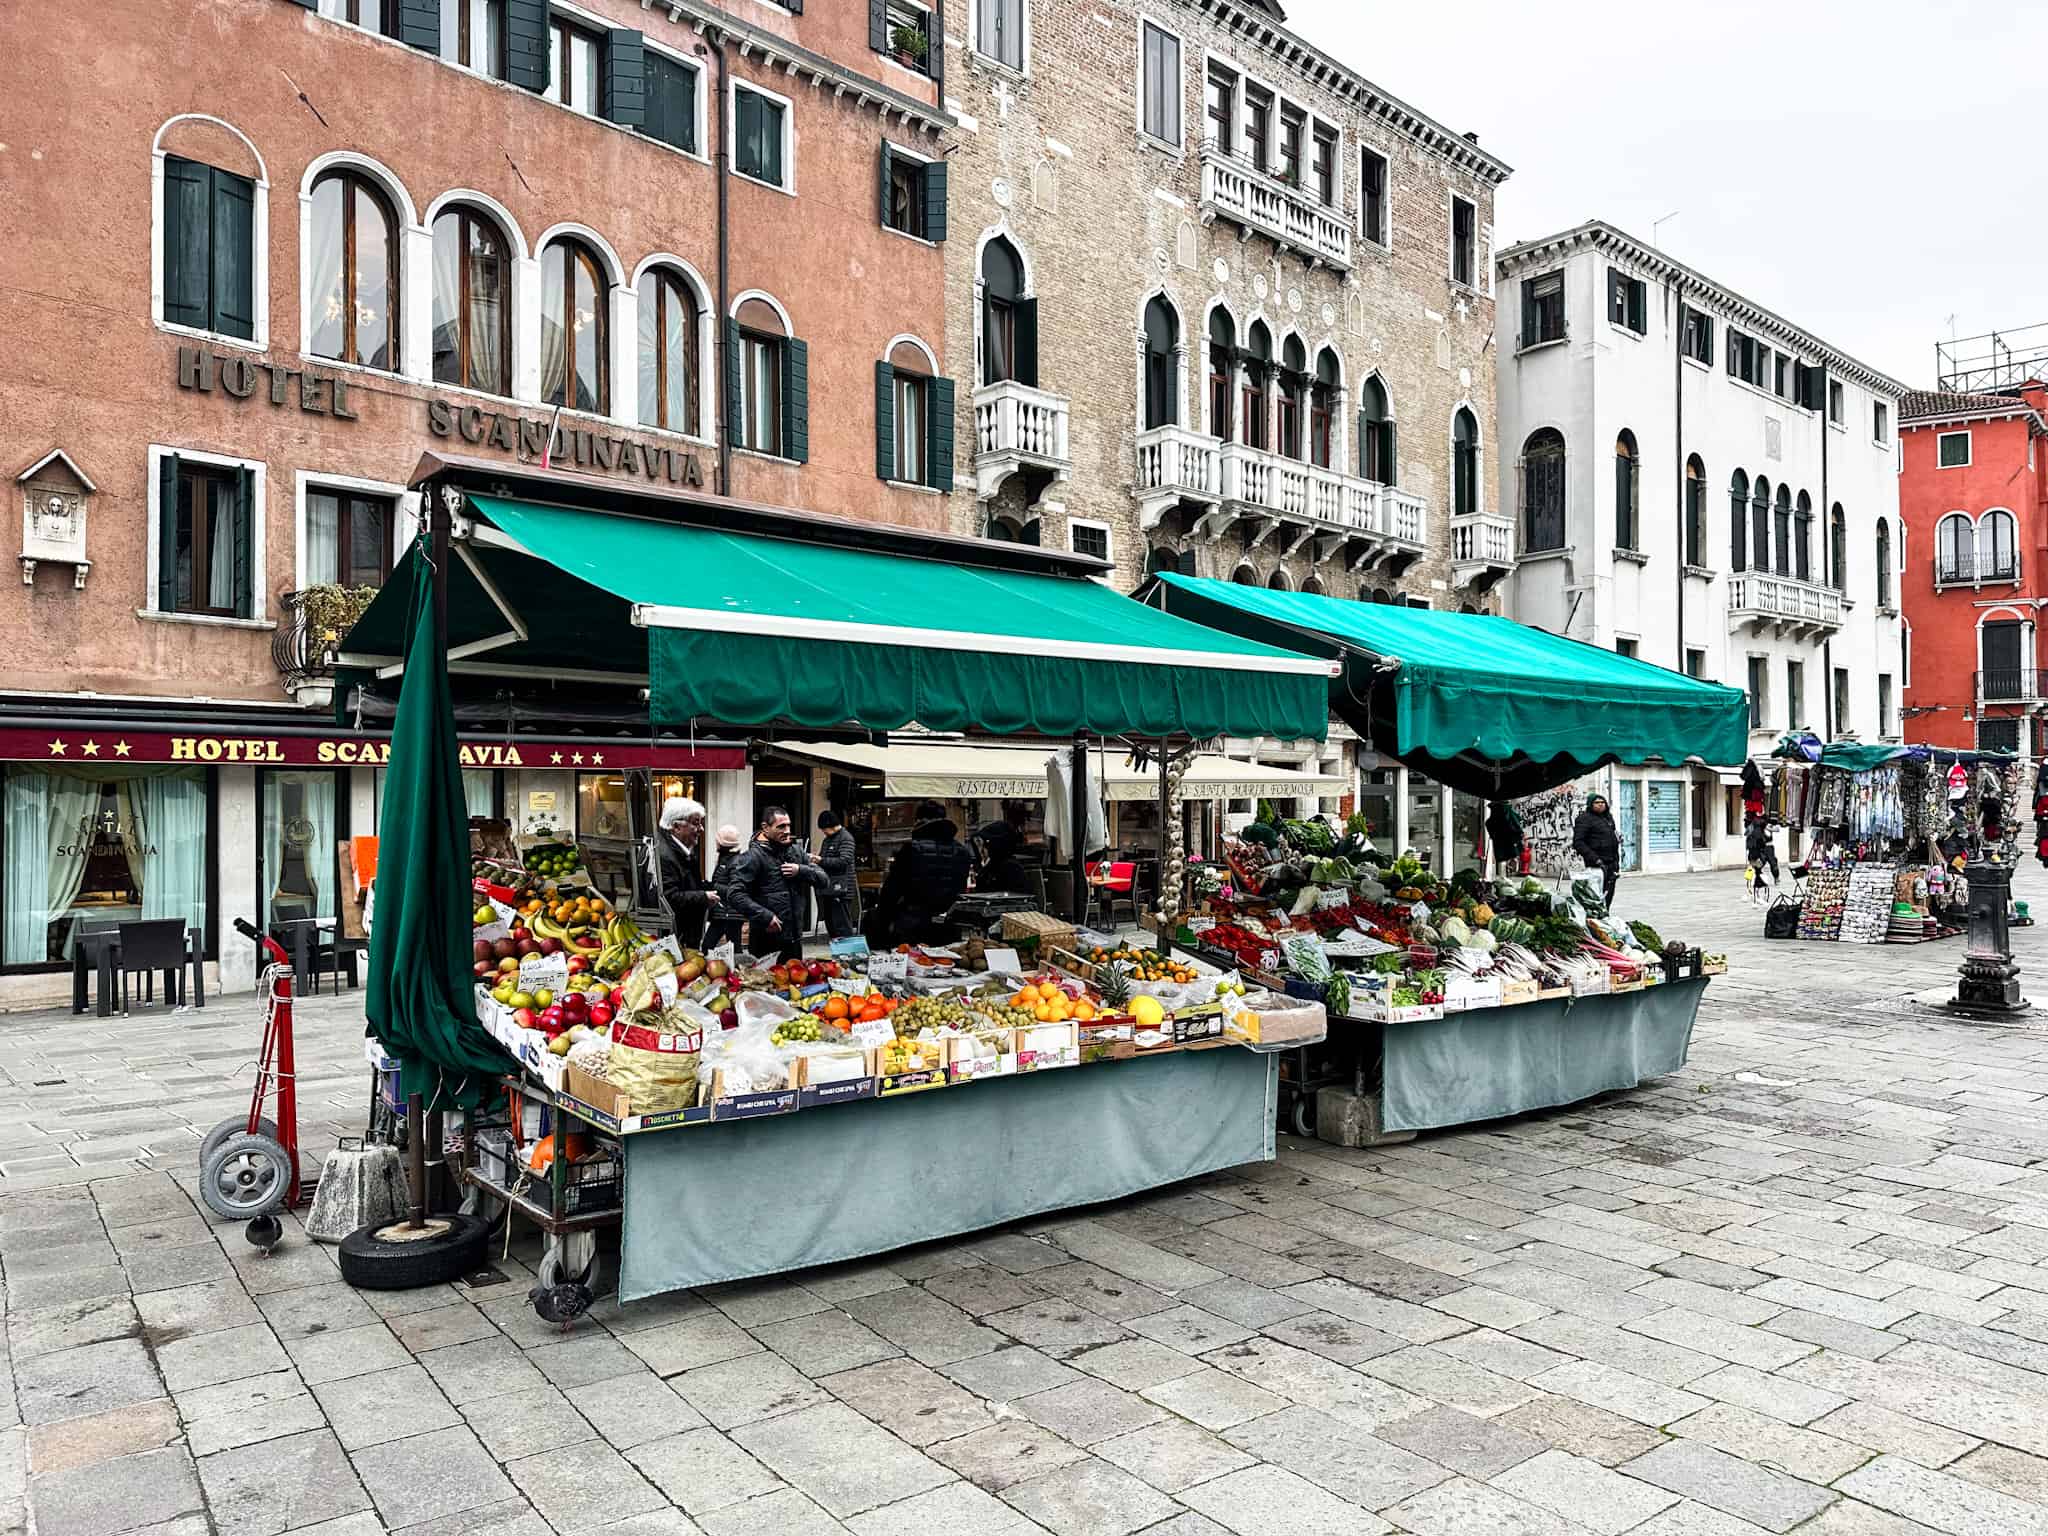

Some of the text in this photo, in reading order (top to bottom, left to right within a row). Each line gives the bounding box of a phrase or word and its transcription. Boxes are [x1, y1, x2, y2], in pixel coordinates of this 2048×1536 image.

[179, 346, 704, 487] HOTEL SCANDINAVIA
[170, 738, 285, 762] HOTEL
[957, 780, 1045, 796] RISTORANTE
[1193, 784, 1226, 797] SANTA
[1231, 784, 1265, 797] MARIA
[1270, 783, 1315, 796] FORMOSA
